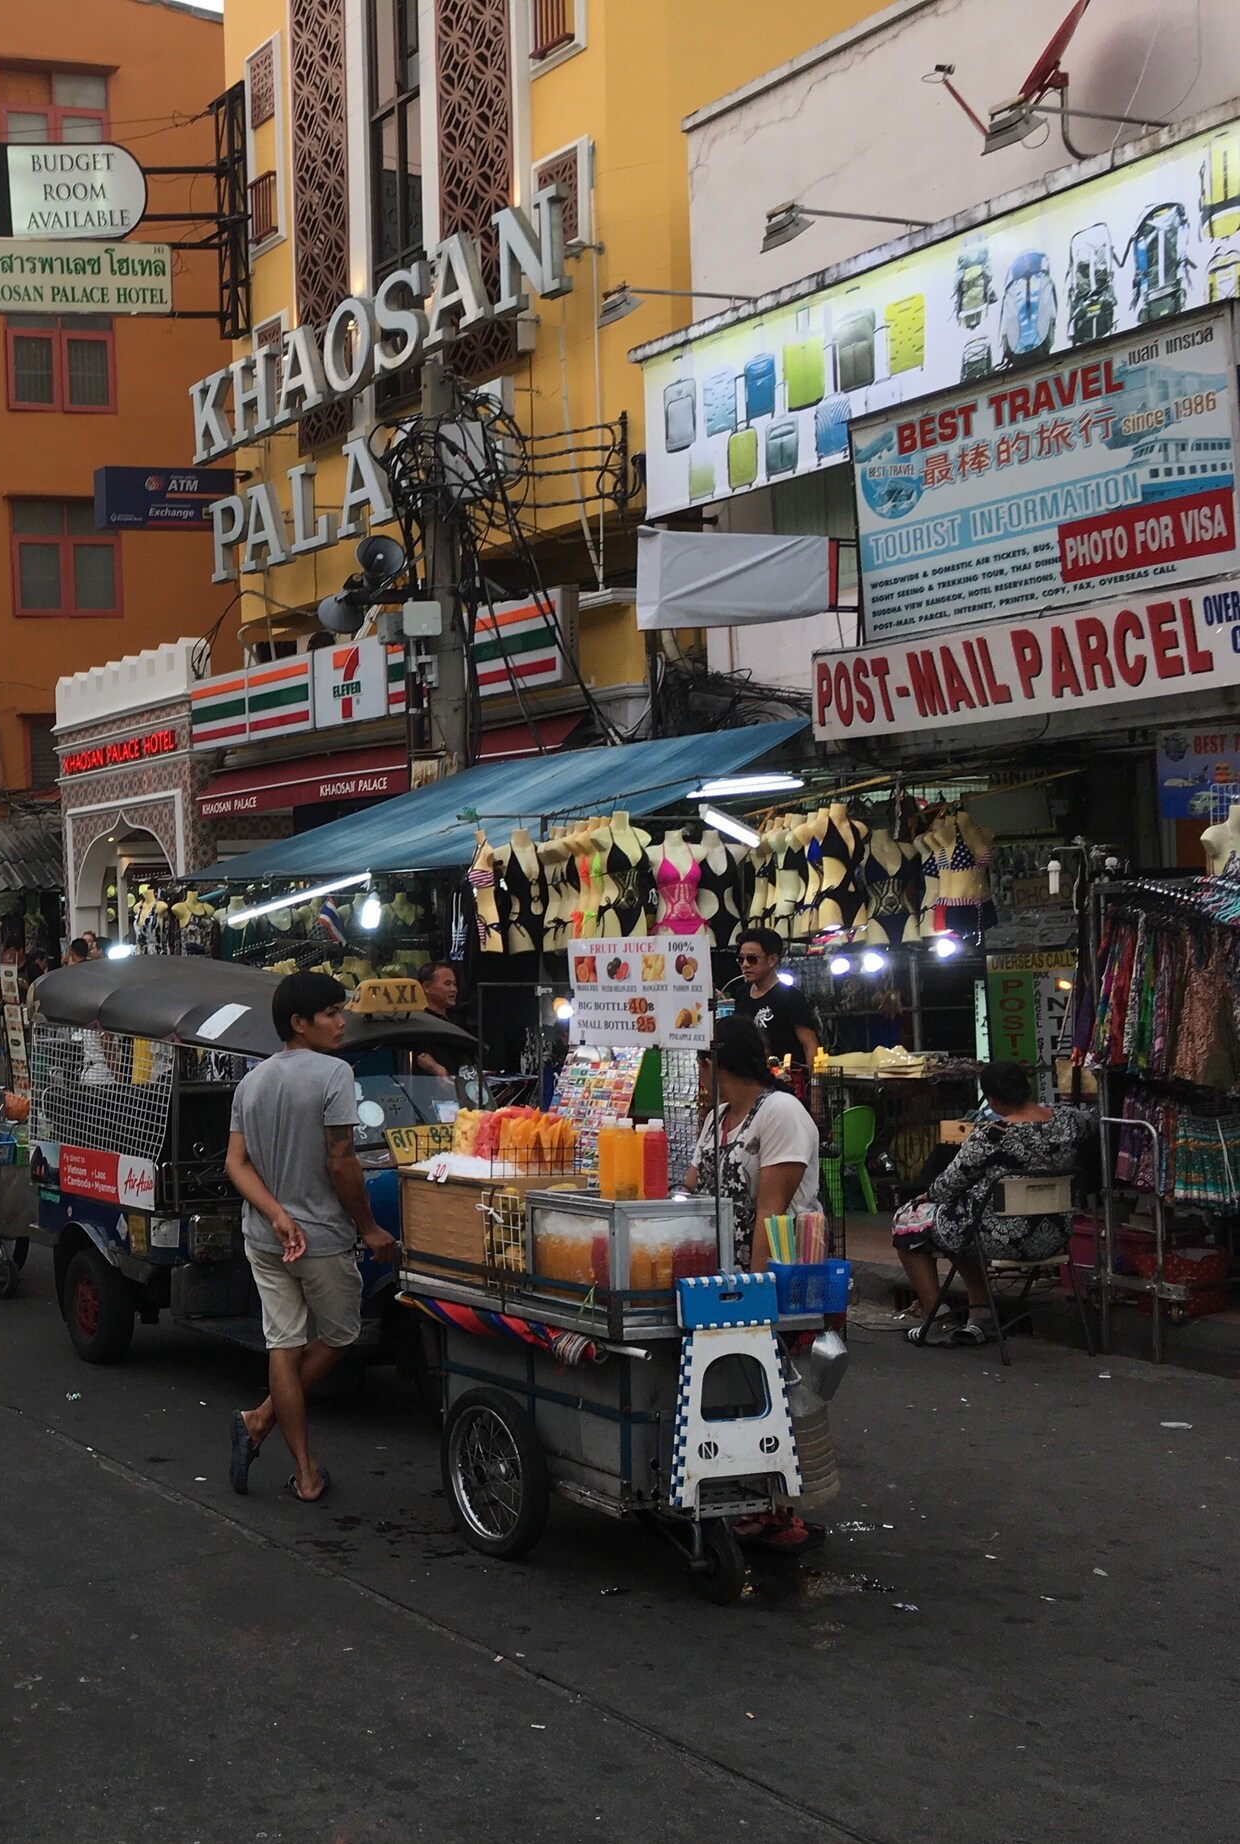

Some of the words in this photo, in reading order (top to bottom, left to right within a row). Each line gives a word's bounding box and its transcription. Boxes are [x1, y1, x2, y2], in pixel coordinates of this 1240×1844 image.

[31, 153, 114, 172] BUDGET
[43, 182, 107, 201] ROOM
[27, 209, 131, 230] AVAILABLE
[104, 249, 167, 278] โฮเทล
[50, 285, 110, 304] PALACE
[116, 287, 168, 305] HOTEL
[189, 184, 573, 466] KHAOSAN
[897, 404, 978, 456] BEST
[988, 356, 1126, 429] TRAVEL
[1122, 409, 1165, 434] since
[1173, 391, 1218, 420] 1986
[920, 406, 1119, 489] 最棒的旅行
[868, 466, 886, 479] BEST
[888, 463, 915, 477] TRAVEL
[168, 479, 199, 492] ATM
[148, 507, 196, 519] Exchange
[870, 515, 960, 565] TOURIST
[970, 472, 1141, 539] INFORMATION
[1065, 524, 1128, 570] PHOTO
[1133, 516, 1176, 556] FOR
[1181, 505, 1228, 546] VISA
[870, 573, 920, 590] WORLDWIDE
[932, 560, 973, 577] DOMESTIC
[975, 556, 990, 566] AIR
[993, 549, 1030, 562] TICKETS,
[1033, 542, 1055, 553] BUS,
[871, 593, 895, 604] SIGHT
[897, 586, 925, 598] SEEING
[937, 576, 979, 590] TREKKING
[982, 569, 1008, 580] TOUR,
[1011, 563, 1032, 574] THAI
[872, 606, 903, 618] BUDDHA
[904, 601, 923, 611] VIEW
[925, 593, 966, 607] BANGKOK,
[968, 588, 992, 598] HOTEL
[994, 573, 1057, 593] RESERVATIONS,
[873, 618, 916, 632] POST-MAIL
[918, 611, 951, 622] PARCEL,
[953, 601, 997, 615] INTERNET,
[999, 593, 1039, 606] PRINTER,
[1042, 586, 1070, 597] COPY,
[1073, 581, 1096, 591] FAX,
[1098, 569, 1150, 586] OVERSEAS
[1152, 564, 1178, 575] CALL
[816, 637, 1012, 728] POST-MAIL
[1010, 597, 1214, 699] PARCEL
[63, 748, 104, 774] KHAOSAN
[106, 738, 140, 763] PALACE
[143, 729, 177, 756] HOTEL
[320, 780, 356, 797] KHAOSAN
[358, 776, 388, 792] PALACE
[202, 800, 232, 815] KHAOSAN
[234, 796, 258, 811] PALACE
[590, 943, 618, 954] FRUIT
[622, 942, 655, 953] JUICE
[667, 941, 695, 952] 100%
[991, 952, 1045, 971] OVERSEAS
[1046, 951, 1073, 967] CALL
[368, 984, 418, 1004] TAXI
[578, 1001, 593, 1011] BIG
[594, 1001, 630, 1012] BOTTLE
[629, 998, 648, 1014] 40
[577, 1019, 603, 1030] SMALL
[604, 1020, 637, 1031] BOTTLE
[636, 1016, 656, 1032] 25
